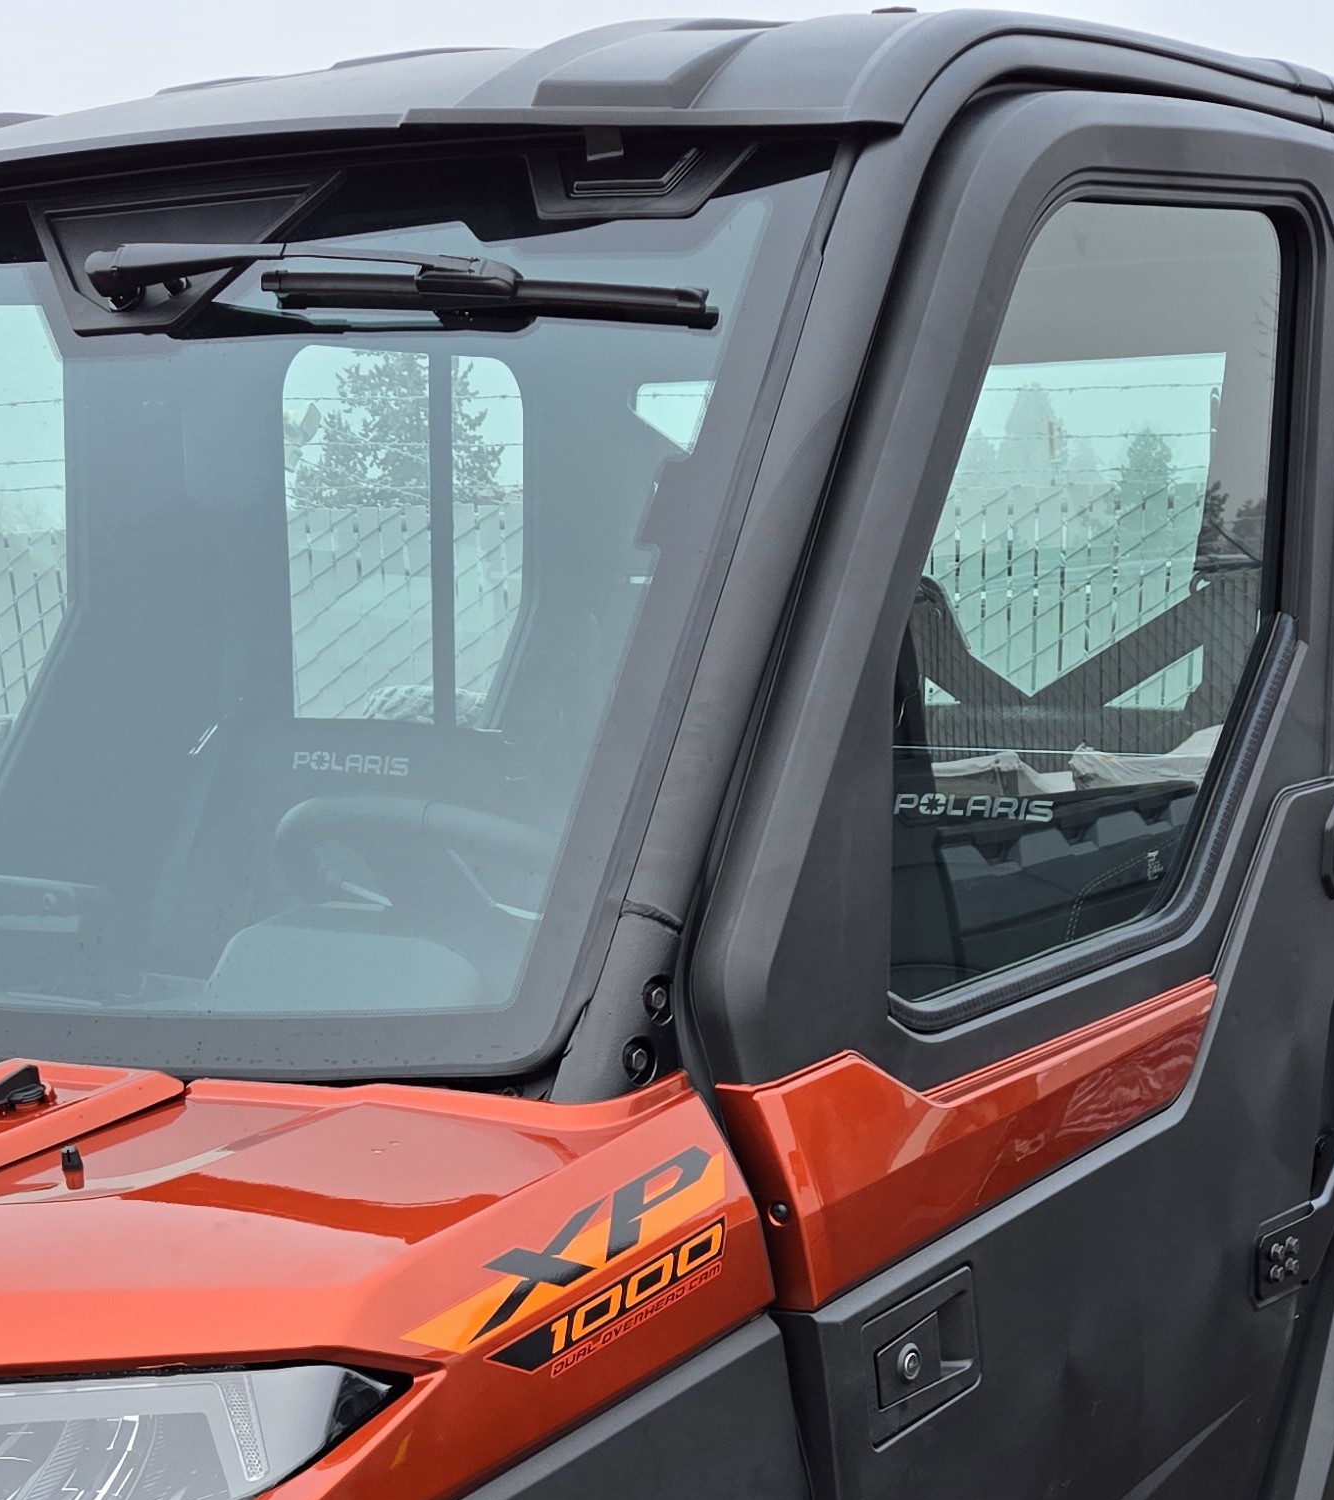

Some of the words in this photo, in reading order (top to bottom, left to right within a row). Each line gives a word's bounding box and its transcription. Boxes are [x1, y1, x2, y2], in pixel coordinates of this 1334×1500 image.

[292, 750, 410, 777] POLARIS
[893, 792, 1054, 822] POLARIS
[467, 1145, 712, 1344] XP
[551, 1222, 723, 1355] 1000
[553, 1343, 597, 1376] DUAL
[601, 1286, 685, 1345] OVERHEAD
[689, 1263, 721, 1290] CAM
